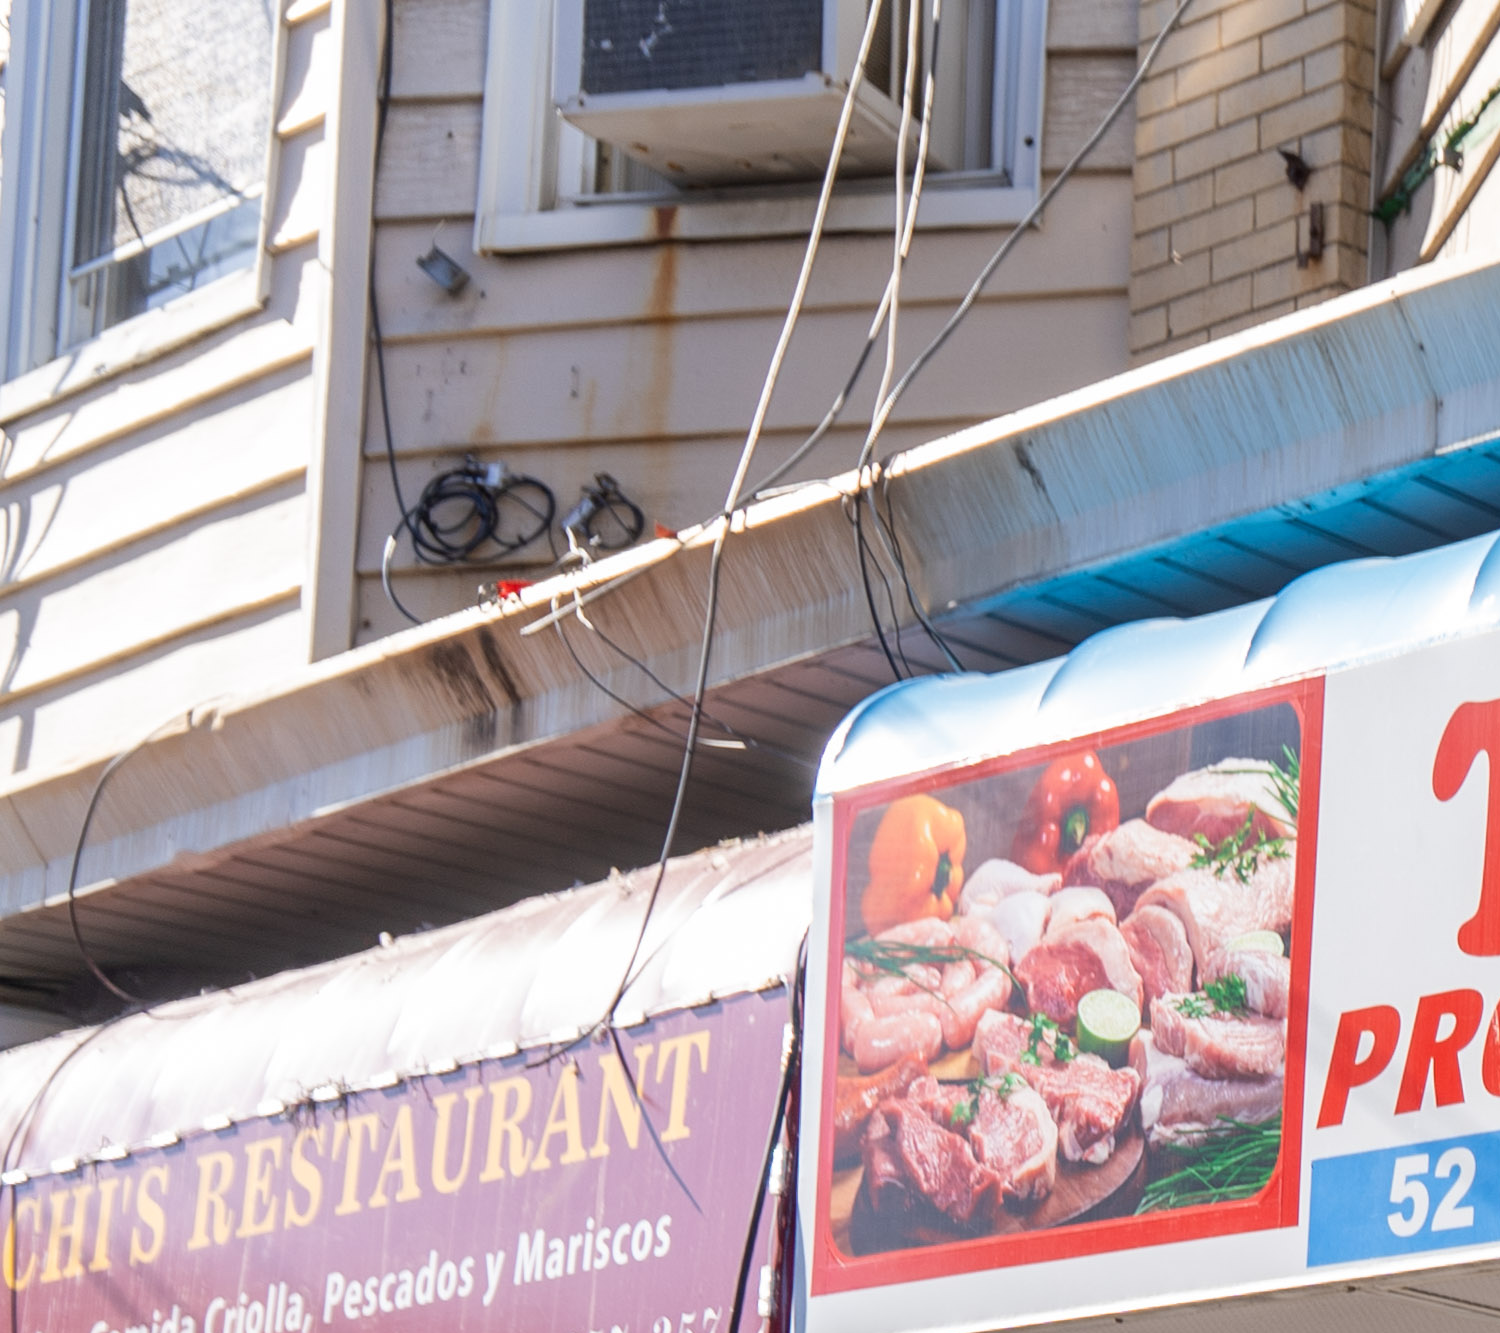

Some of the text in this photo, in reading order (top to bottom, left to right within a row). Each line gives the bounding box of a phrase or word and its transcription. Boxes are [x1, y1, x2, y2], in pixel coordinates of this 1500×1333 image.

[187, 1031, 711, 1250] RESTAURANT
[1386, 1145, 1477, 1238] 52
[323, 1248, 474, 1326] Pescados
[483, 1252, 506, 1317] y
[513, 1213, 673, 1286] Mariscos
